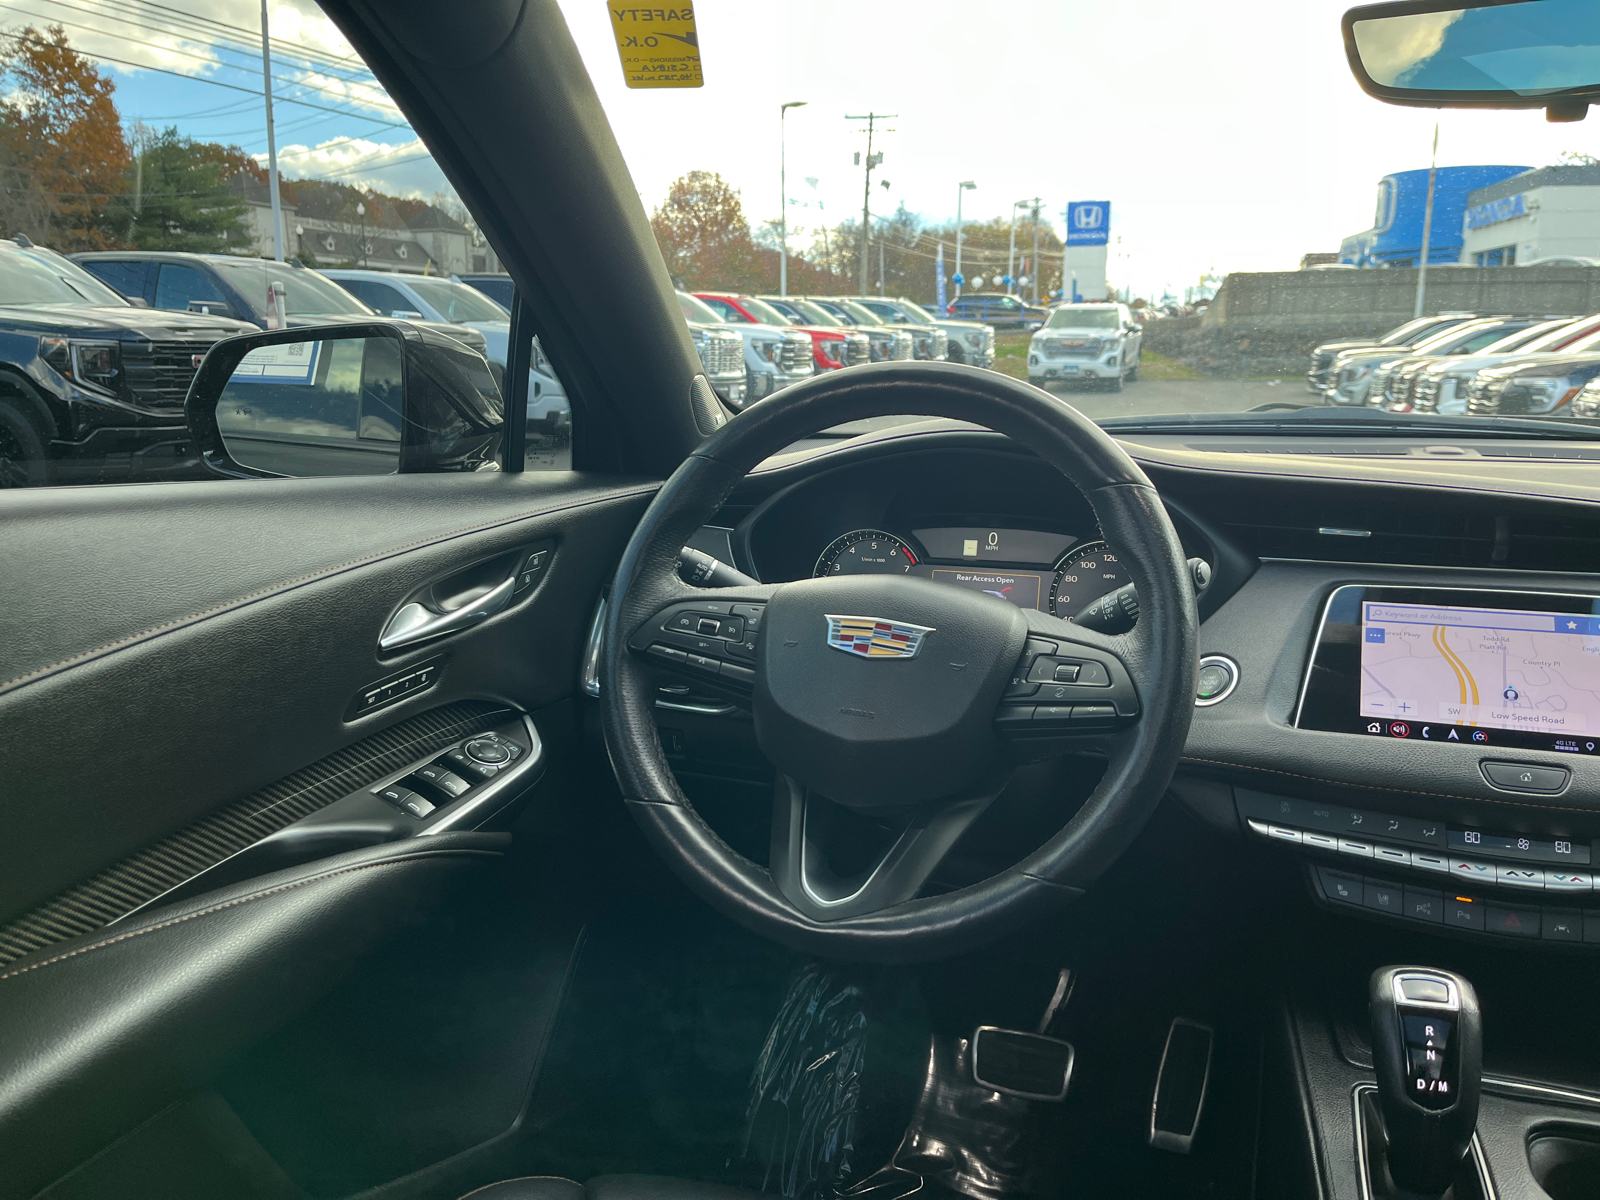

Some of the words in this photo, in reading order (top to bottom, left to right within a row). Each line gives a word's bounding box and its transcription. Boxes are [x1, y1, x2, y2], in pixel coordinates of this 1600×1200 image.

[988, 532, 998, 545] 0
[890, 548, 896, 556] 6
[834, 564, 840, 572] 3
[1080, 561, 1097, 569] 100
[956, 573, 971, 582] Rear
[973, 575, 994, 583] Access
[996, 576, 1015, 586] Open
[1065, 575, 1078, 583] 80
[1385, 611, 1418, 619] Keyword
[1430, 614, 1463, 622] Address
[1403, 631, 1421, 639] Pkwy
[1523, 659, 1552, 667] Country
[839, 708, 875, 719] AIRBAG
[1512, 714, 1540, 723] Speed
[1542, 717, 1565, 725] Road
[1464, 831, 1481, 844] 80
[1554, 841, 1571, 854] 80
[1425, 1026, 1434, 1036] R
[1426, 1050, 1436, 1060] N
[1416, 1079, 1426, 1089] D
[1438, 1081, 1448, 1092] M
